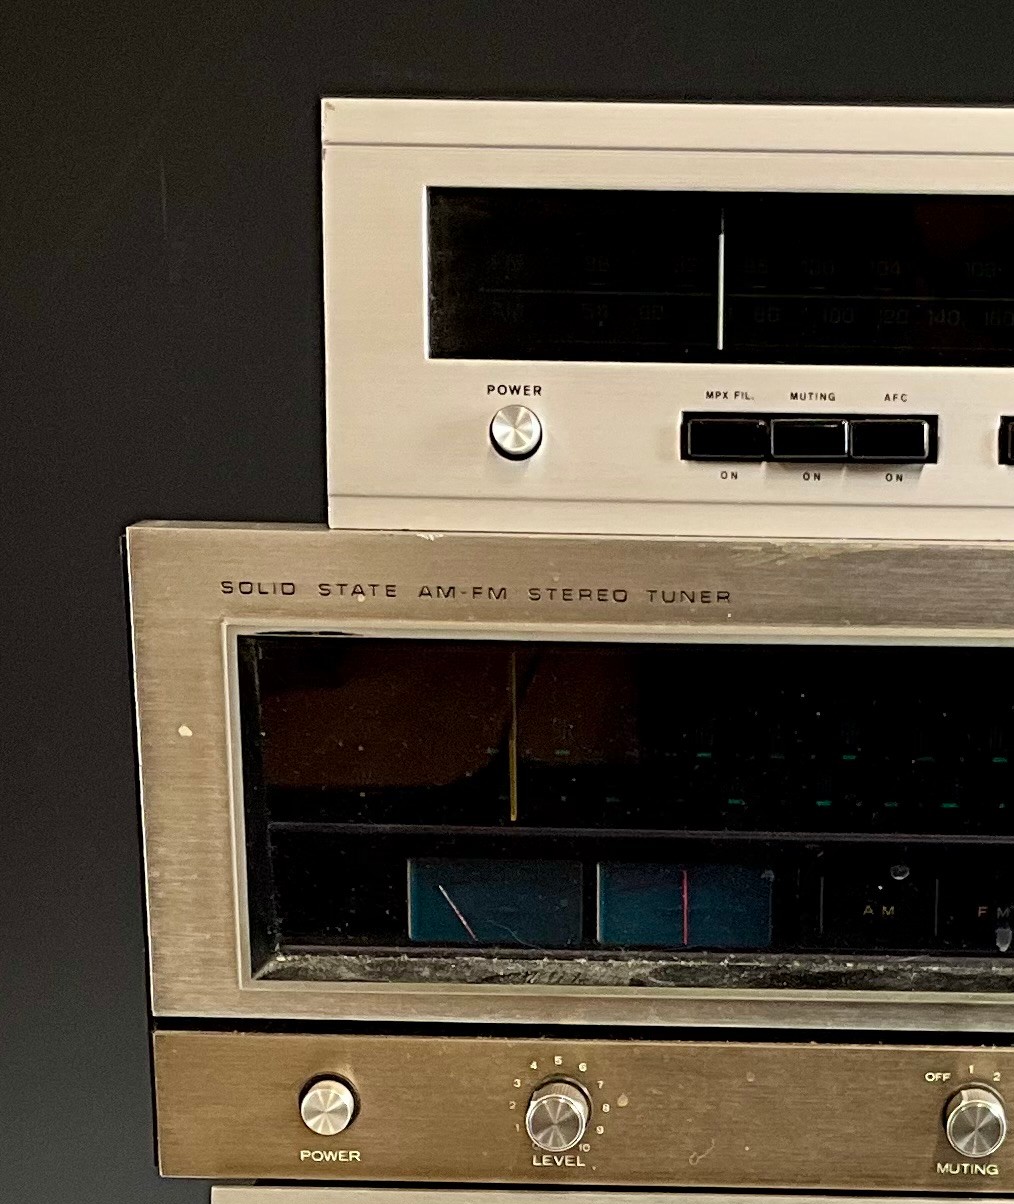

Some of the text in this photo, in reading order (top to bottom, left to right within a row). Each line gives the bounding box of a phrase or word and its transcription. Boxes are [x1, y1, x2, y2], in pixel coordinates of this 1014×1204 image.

[486, 384, 543, 397] POWER
[705, 390, 755, 401] MPX FIL.
[789, 391, 837, 402] MUTING
[883, 392, 909, 403] AFC
[719, 470, 739, 481] ON
[802, 471, 822, 482] ON
[885, 472, 904, 483] ON
[220, 580, 732, 605] SOLID STATE AM-FM STEREO TUNER
[924, 1071, 952, 1083] OFF
[992, 1071, 1002, 1083] 2
[299, 1149, 362, 1163] POWER
[532, 1154, 586, 1168] LEVEL
[935, 1162, 1000, 1176] MUTING
